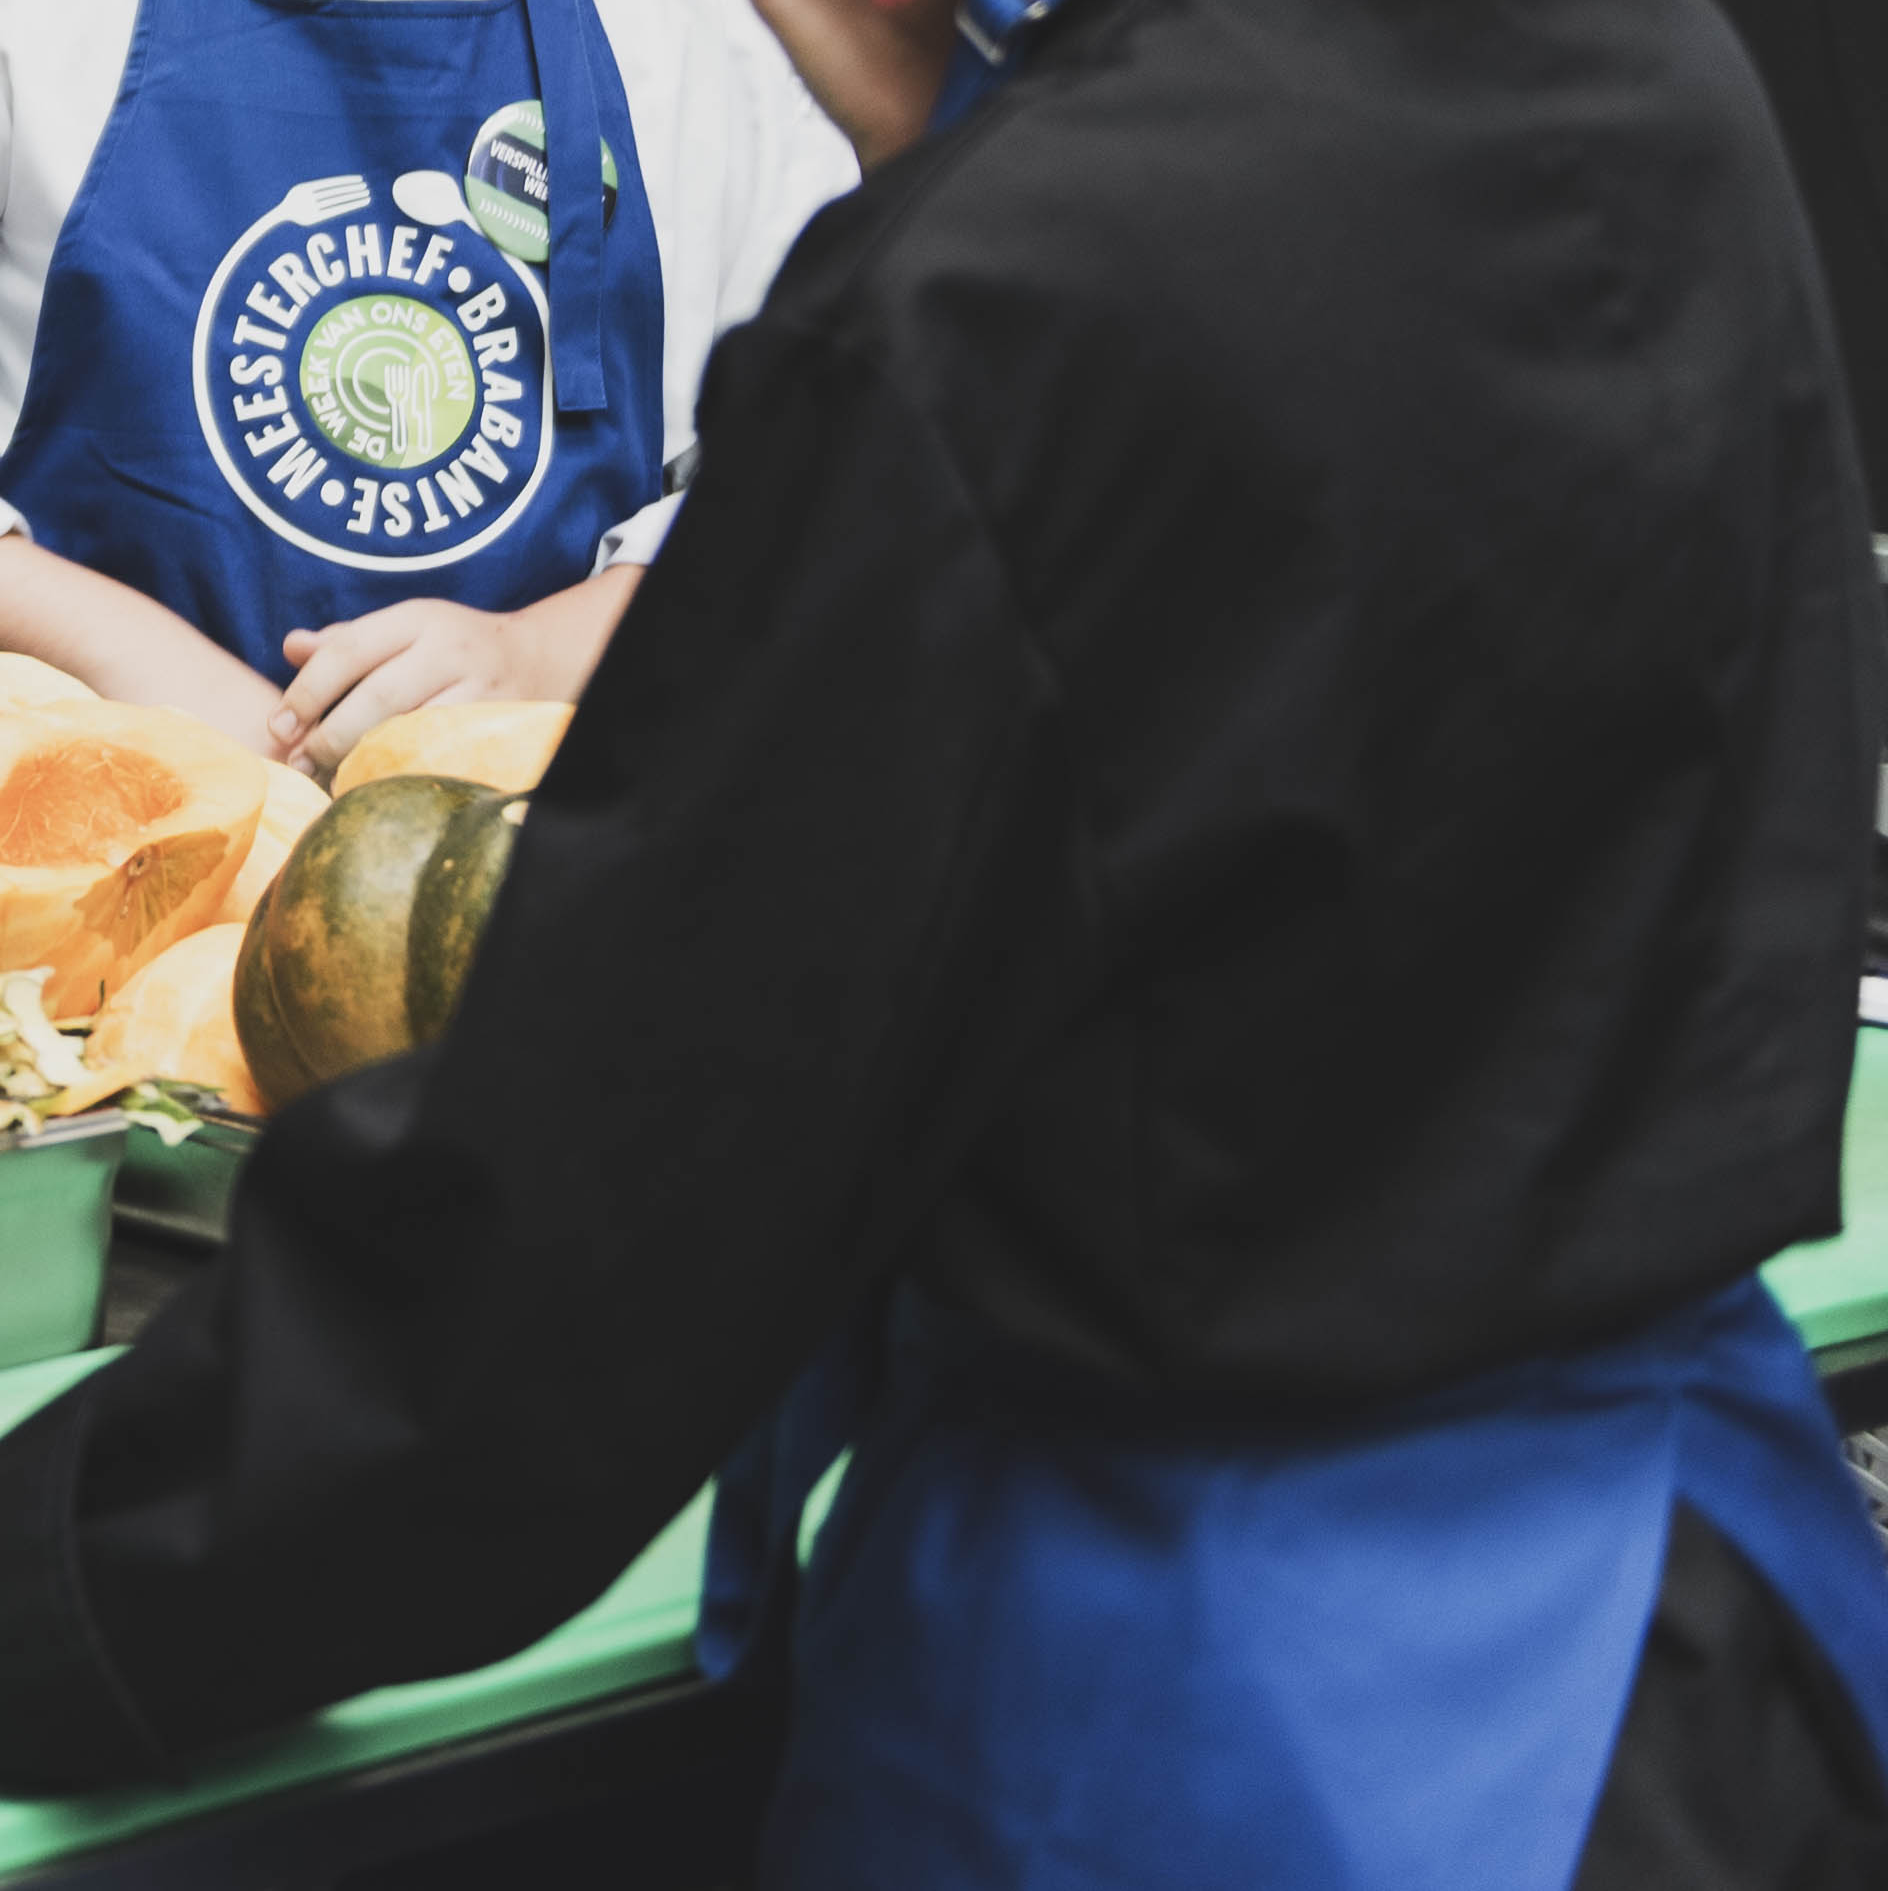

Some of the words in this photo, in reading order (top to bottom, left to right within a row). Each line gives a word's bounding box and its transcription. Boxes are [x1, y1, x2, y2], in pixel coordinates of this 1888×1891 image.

[314, 305, 369, 352] VAN
[369, 300, 430, 337] ONS
[228, 223, 456, 501] MEESTERCHEF
[305, 353, 349, 440] WEEK
[425, 323, 471, 403] ETEN
[345, 280, 524, 539] BRABANTSE
[345, 434, 388, 462] DE
